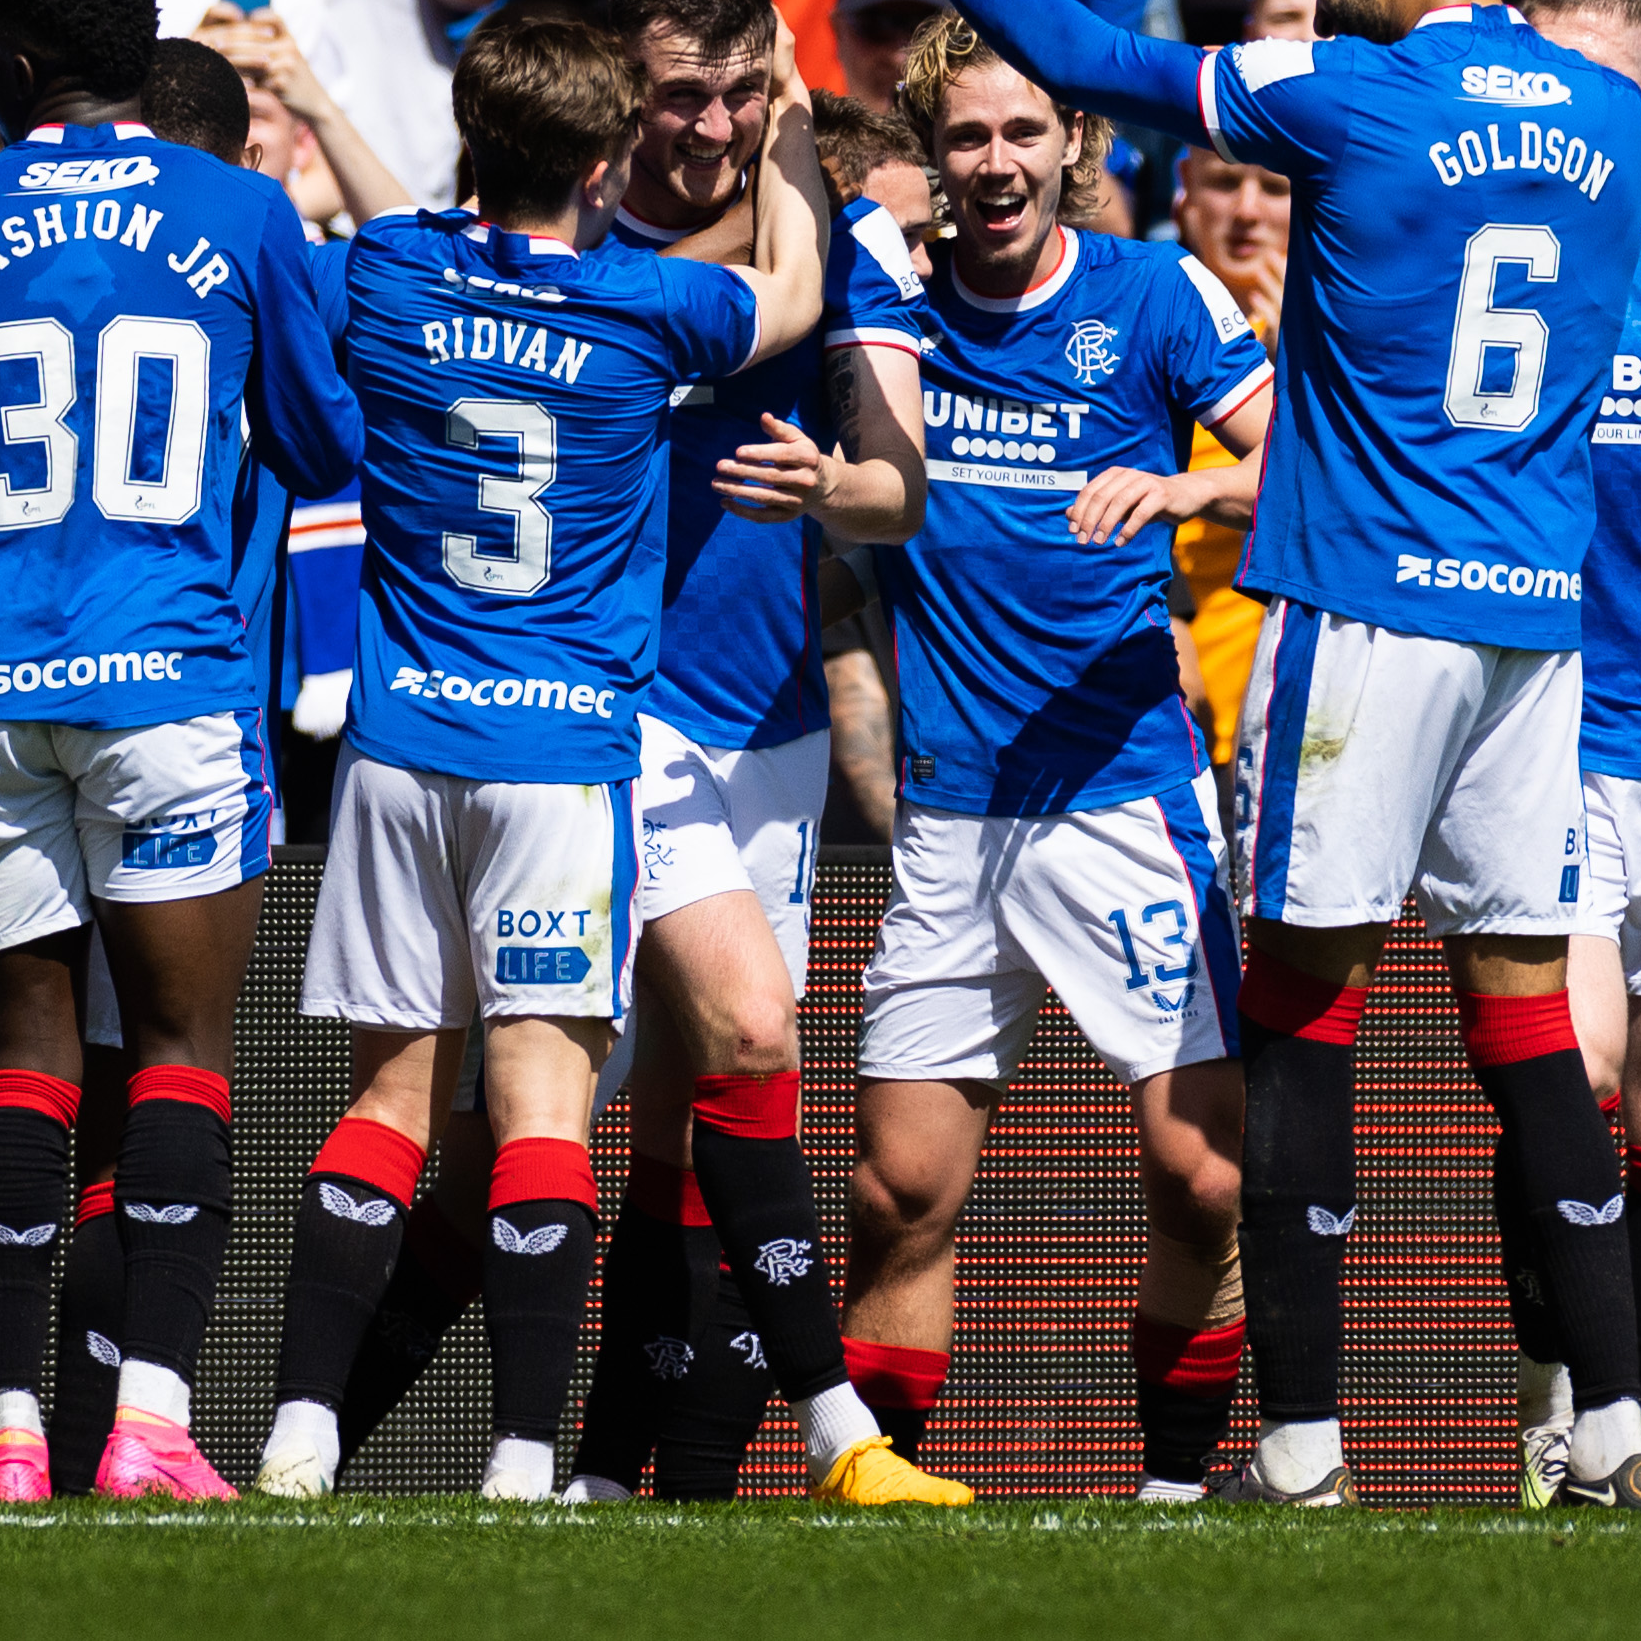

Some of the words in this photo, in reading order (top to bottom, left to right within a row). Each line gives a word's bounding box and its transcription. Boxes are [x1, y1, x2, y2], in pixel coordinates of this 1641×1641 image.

[1460, 66, 1571, 104] SEKO
[13, 155, 160, 192] SEKO
[1428, 123, 1614, 202] GOLDSON
[167, 236, 230, 300] JR
[421, 317, 593, 385] RIDVAN
[1444, 224, 1561, 432] 6
[923, 390, 1090, 440] UNIBET
[1596, 427, 1624, 440] OUR
[442, 397, 559, 597] 3
[950, 468, 975, 481] SET
[977, 470, 1009, 484] YOUR
[1011, 473, 1057, 487] LIMITS
[1435, 556, 1582, 602] socome
[426, 670, 615, 719] socomec
[133, 837, 202, 865] LIFE
[497, 909, 592, 939] BOXT
[1106, 897, 1199, 993] 13
[502, 950, 574, 982] LIFE
[1158, 1009, 1199, 1025] CASTORE
